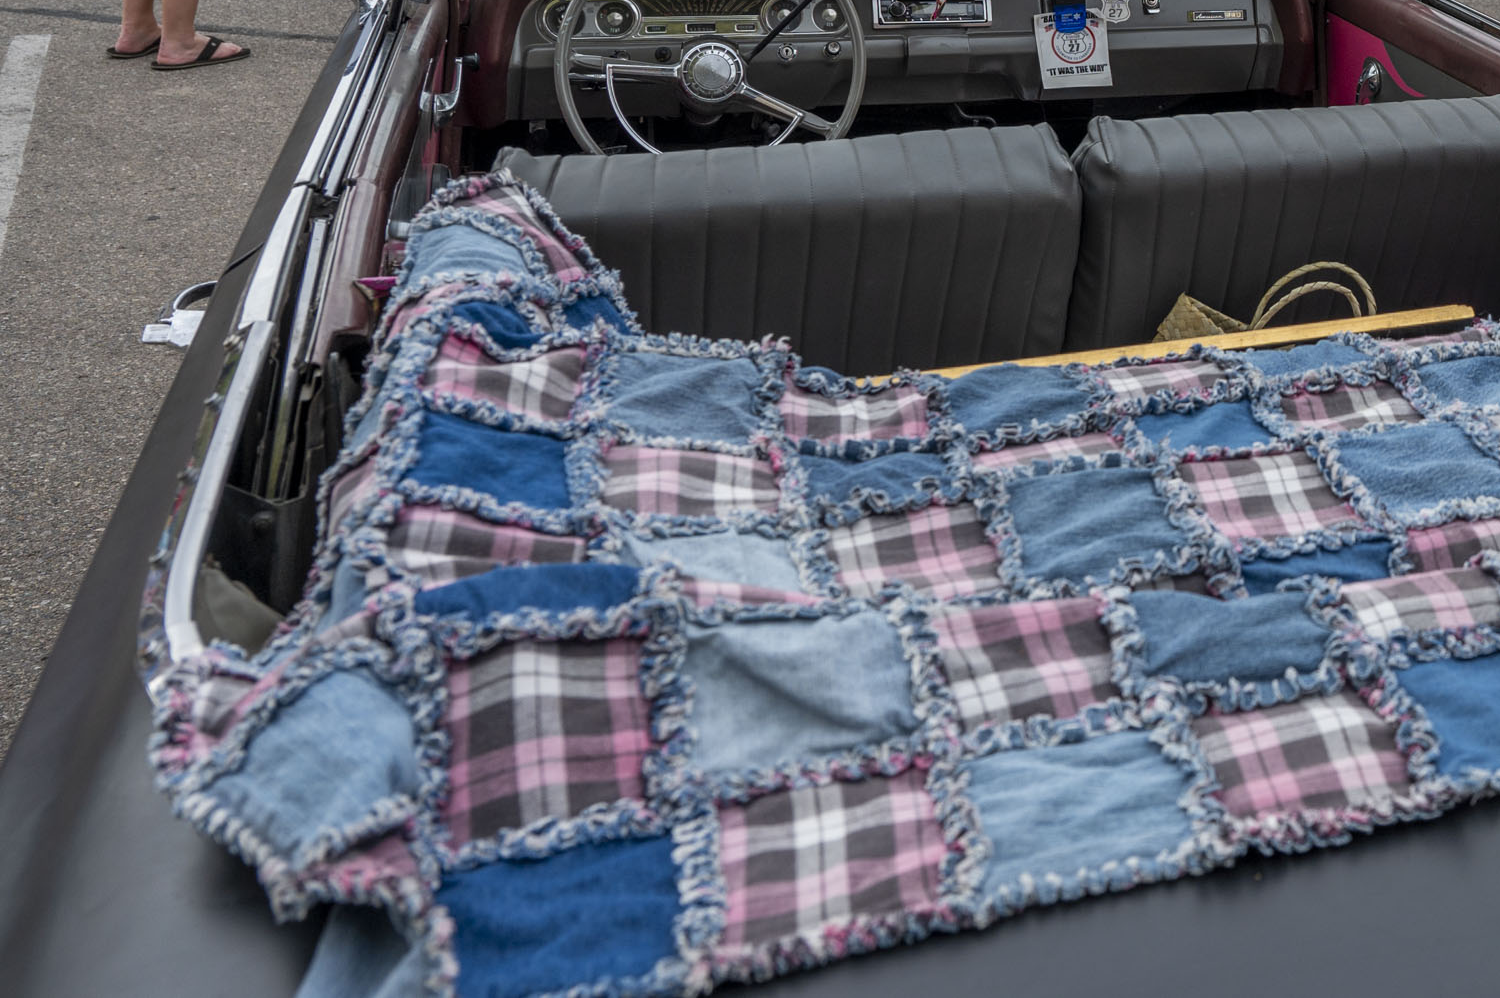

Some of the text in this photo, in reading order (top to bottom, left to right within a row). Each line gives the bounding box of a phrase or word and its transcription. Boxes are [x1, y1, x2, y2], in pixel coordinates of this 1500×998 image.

[1108, 8, 1123, 18] 27
[1068, 43, 1080, 53] 27
[1058, 66, 1075, 75] WAS
[1076, 65, 1089, 74] THE
